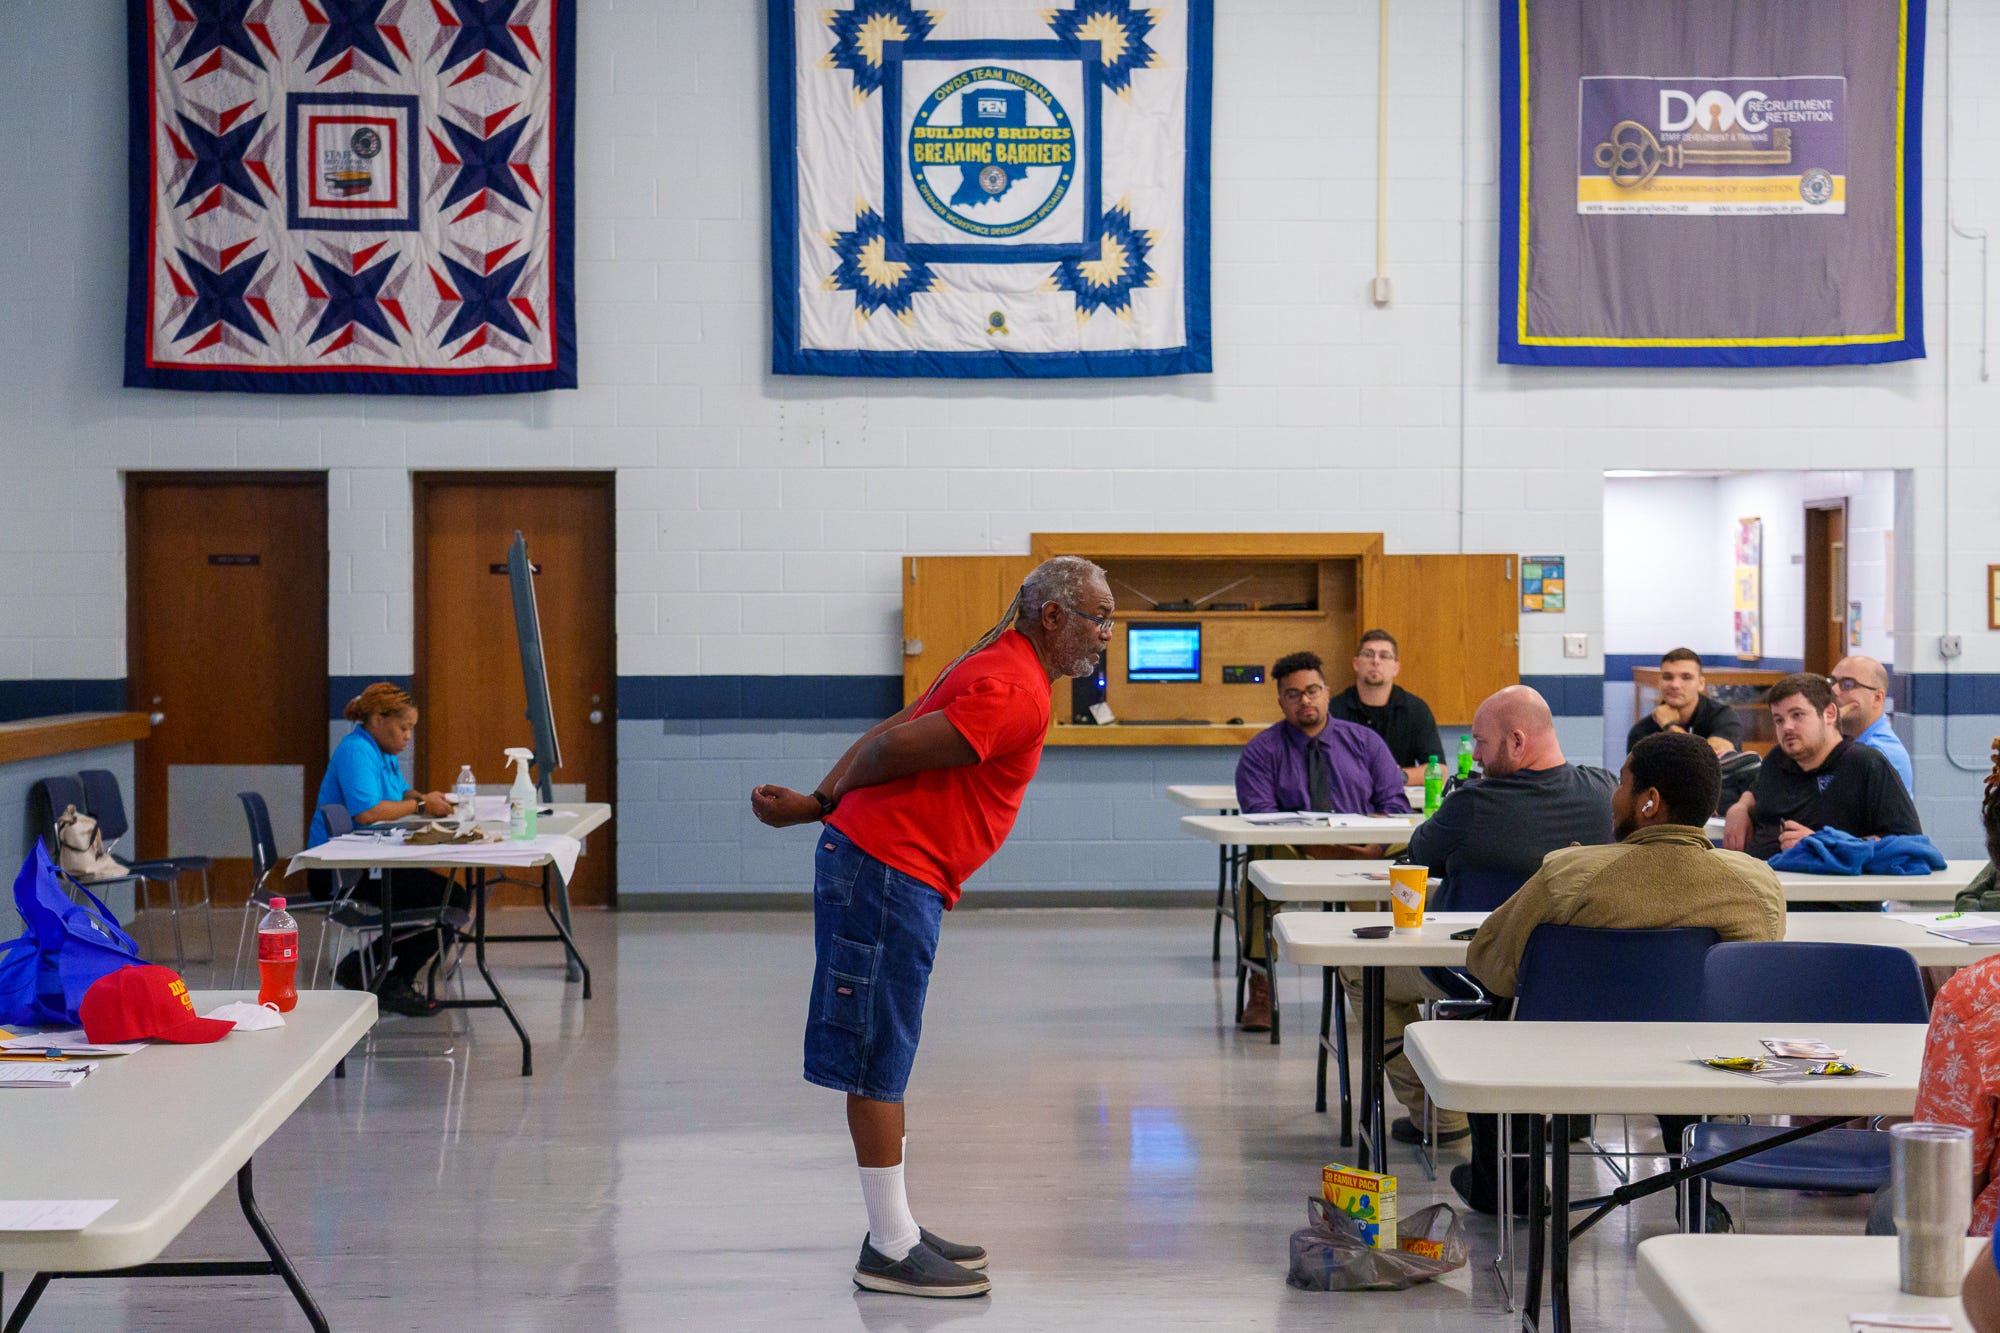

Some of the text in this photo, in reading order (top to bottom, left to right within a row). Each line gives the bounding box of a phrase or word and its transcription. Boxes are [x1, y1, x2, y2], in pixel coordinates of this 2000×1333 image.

[934, 69, 1053, 106] OWDS TEAM INDIANA
[978, 100, 1008, 113] PEN
[1660, 89, 1769, 133] DOC
[1748, 100, 1833, 112] RECRUITMENT
[1751, 111, 1833, 123] & RETENTION
[913, 127, 1071, 140] BUILDING BRIDGES
[913, 142, 1072, 164] BREAKING BARRIERS
[945, 212, 990, 235] WORKFORCE
[1333, 1173, 1358, 1188] FAMILY
[1359, 1178, 1378, 1192] PACK
